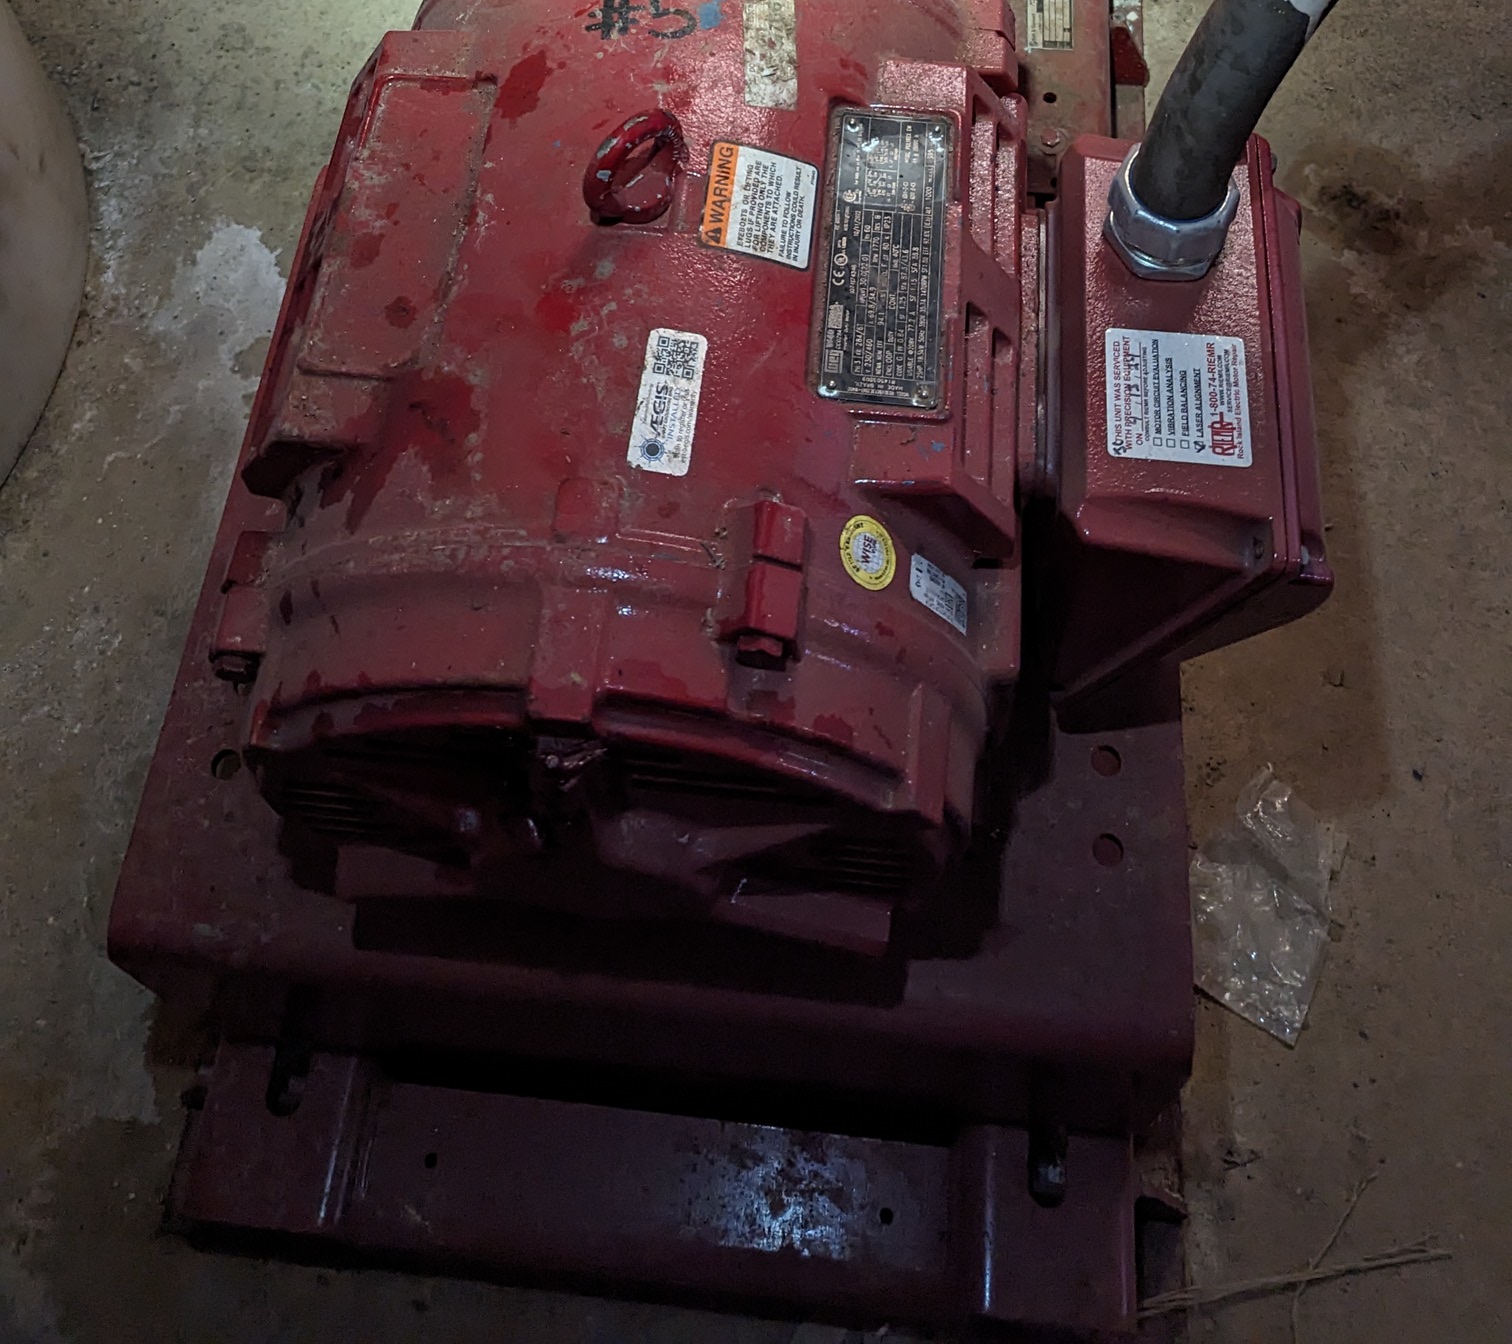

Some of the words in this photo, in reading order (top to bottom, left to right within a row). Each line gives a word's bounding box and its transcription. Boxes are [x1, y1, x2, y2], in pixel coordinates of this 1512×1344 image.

[743, 164, 754, 192] LIFTING
[754, 160, 762, 176] ARE
[761, 164, 769, 179] THE
[768, 161, 777, 187] WHICH
[794, 167, 802, 190] RESULT
[709, 145, 734, 226] WARNING
[749, 177, 760, 217] PROVIDED
[758, 181, 767, 201] ONLY
[766, 189, 773, 200] TO
[742, 194, 750, 206] OR
[767, 233, 775, 254] THEY
[772, 174, 783, 215] ATTACHED.
[783, 191, 792, 219] FOLLOW
[791, 191, 799, 213] COULD
[737, 208, 748, 247] EYEBOLTS
[755, 202, 764, 232] LIFTING
[759, 201, 772, 253] COMPONENTS
[782, 219, 788, 228] TO
[796, 219, 802, 229] OR
[745, 227, 753, 249] LUGS
[752, 234, 760, 251] FOR
[778, 229, 787, 257] FAILURE
[785, 213, 797, 260] INSTRUCTIONS
[793, 230, 801, 254] INJURY
[832, 270, 845, 286] CE
[865, 339, 874, 367] 230/460
[1113, 341, 1121, 380] SERVICED
[1123, 336, 1131, 381] EQUIPMENT
[1231, 344, 1239, 366] Repair
[1165, 358, 1173, 393] ANALYSIS
[1194, 368, 1202, 411] ALIGNMENT
[1207, 342, 1219, 417] 1-800-74-RIEMR
[1217, 355, 1225, 406] WWW.RIEMR.COM
[1224, 349, 1233, 413] SERVICE@RIEMR.COM
[1124, 384, 1132, 427] PRECISION
[1180, 370, 1188, 413] BALANCING
[1233, 390, 1241, 416] Electric
[668, 387, 681, 439] INSTALLED
[1167, 394, 1175, 435] VIBRATION
[1195, 412, 1203, 438] LASER
[1125, 429, 1133, 450] WITH
[1136, 433, 1143, 446] ON
[1235, 418, 1243, 440] Island
[861, 535, 874, 564] WISE
